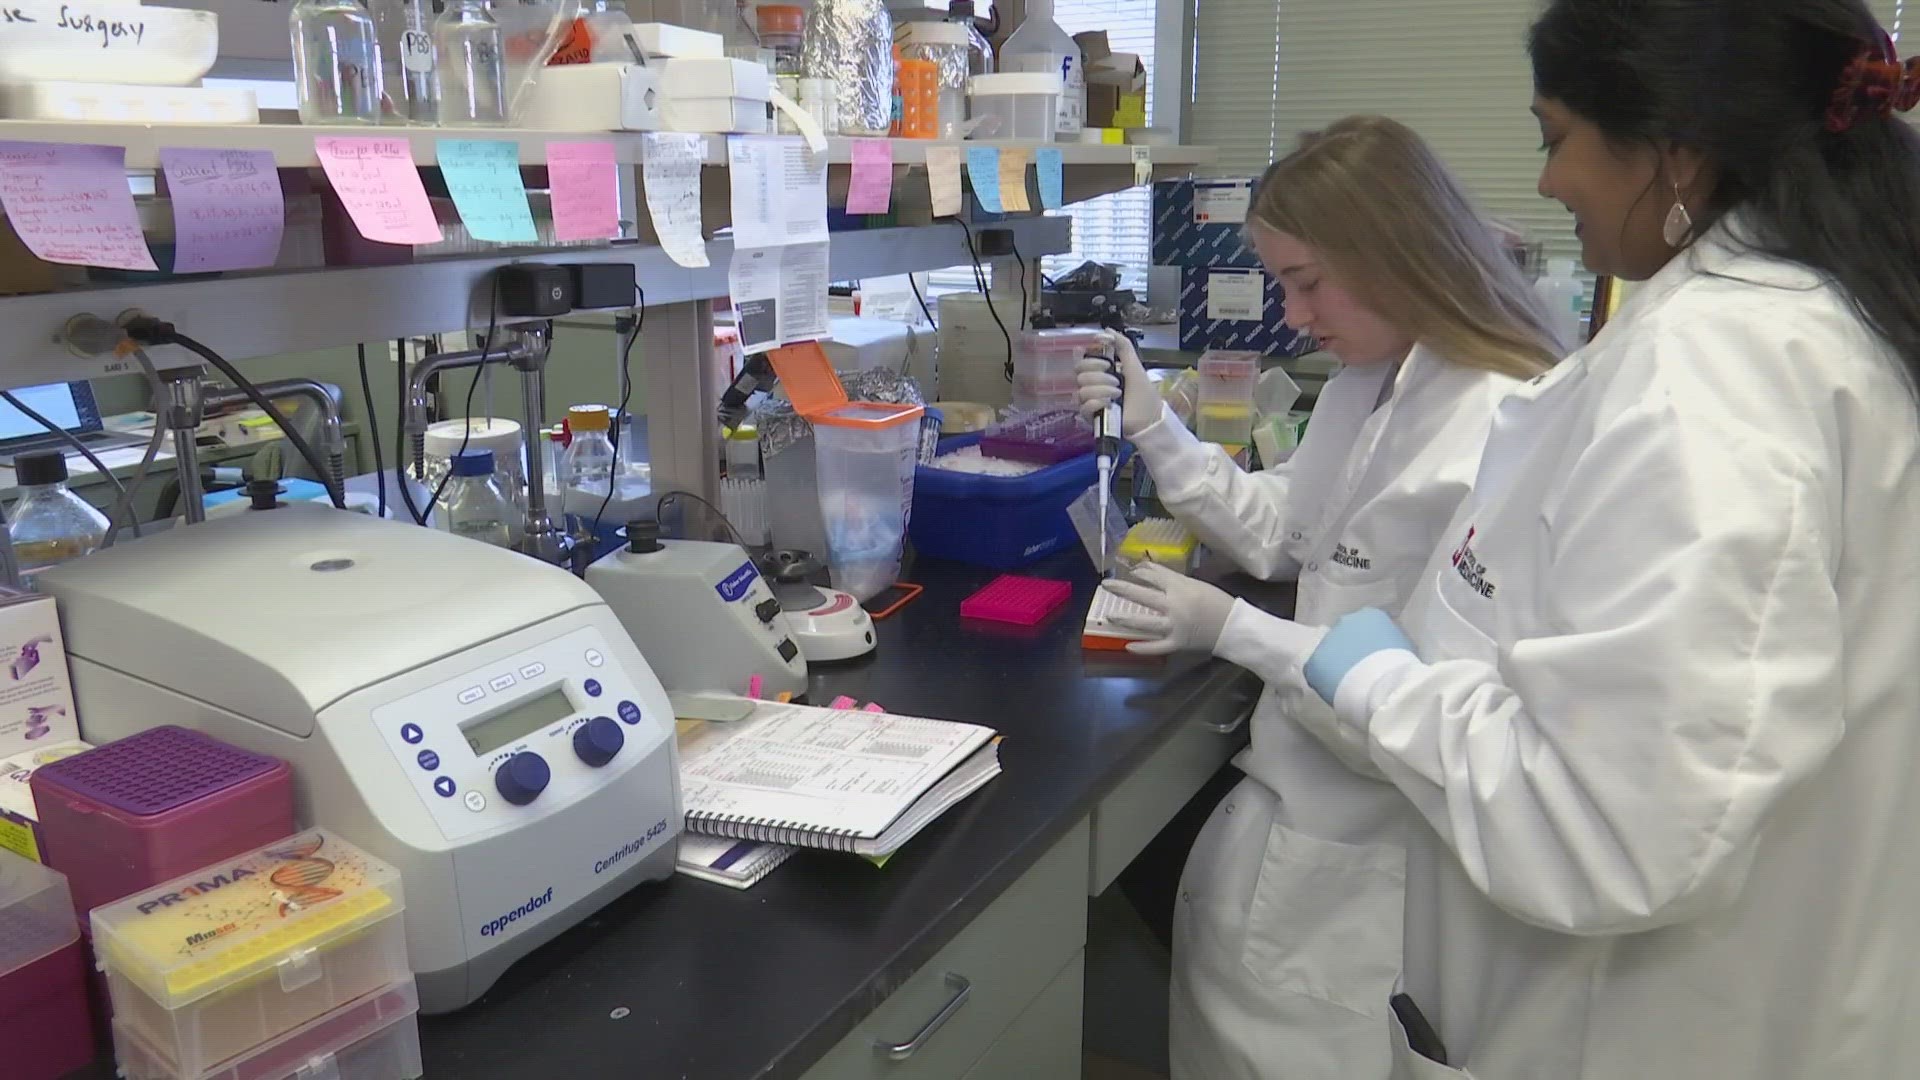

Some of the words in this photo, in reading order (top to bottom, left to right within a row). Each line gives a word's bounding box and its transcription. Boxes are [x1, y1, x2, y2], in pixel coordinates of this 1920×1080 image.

[57, 5, 145, 48] Surgery
[407, 32, 431, 54] PBS
[594, 835, 645, 874] Centrifuge
[646, 818, 667, 841] 5425
[480, 886, 553, 937] eppendorf
